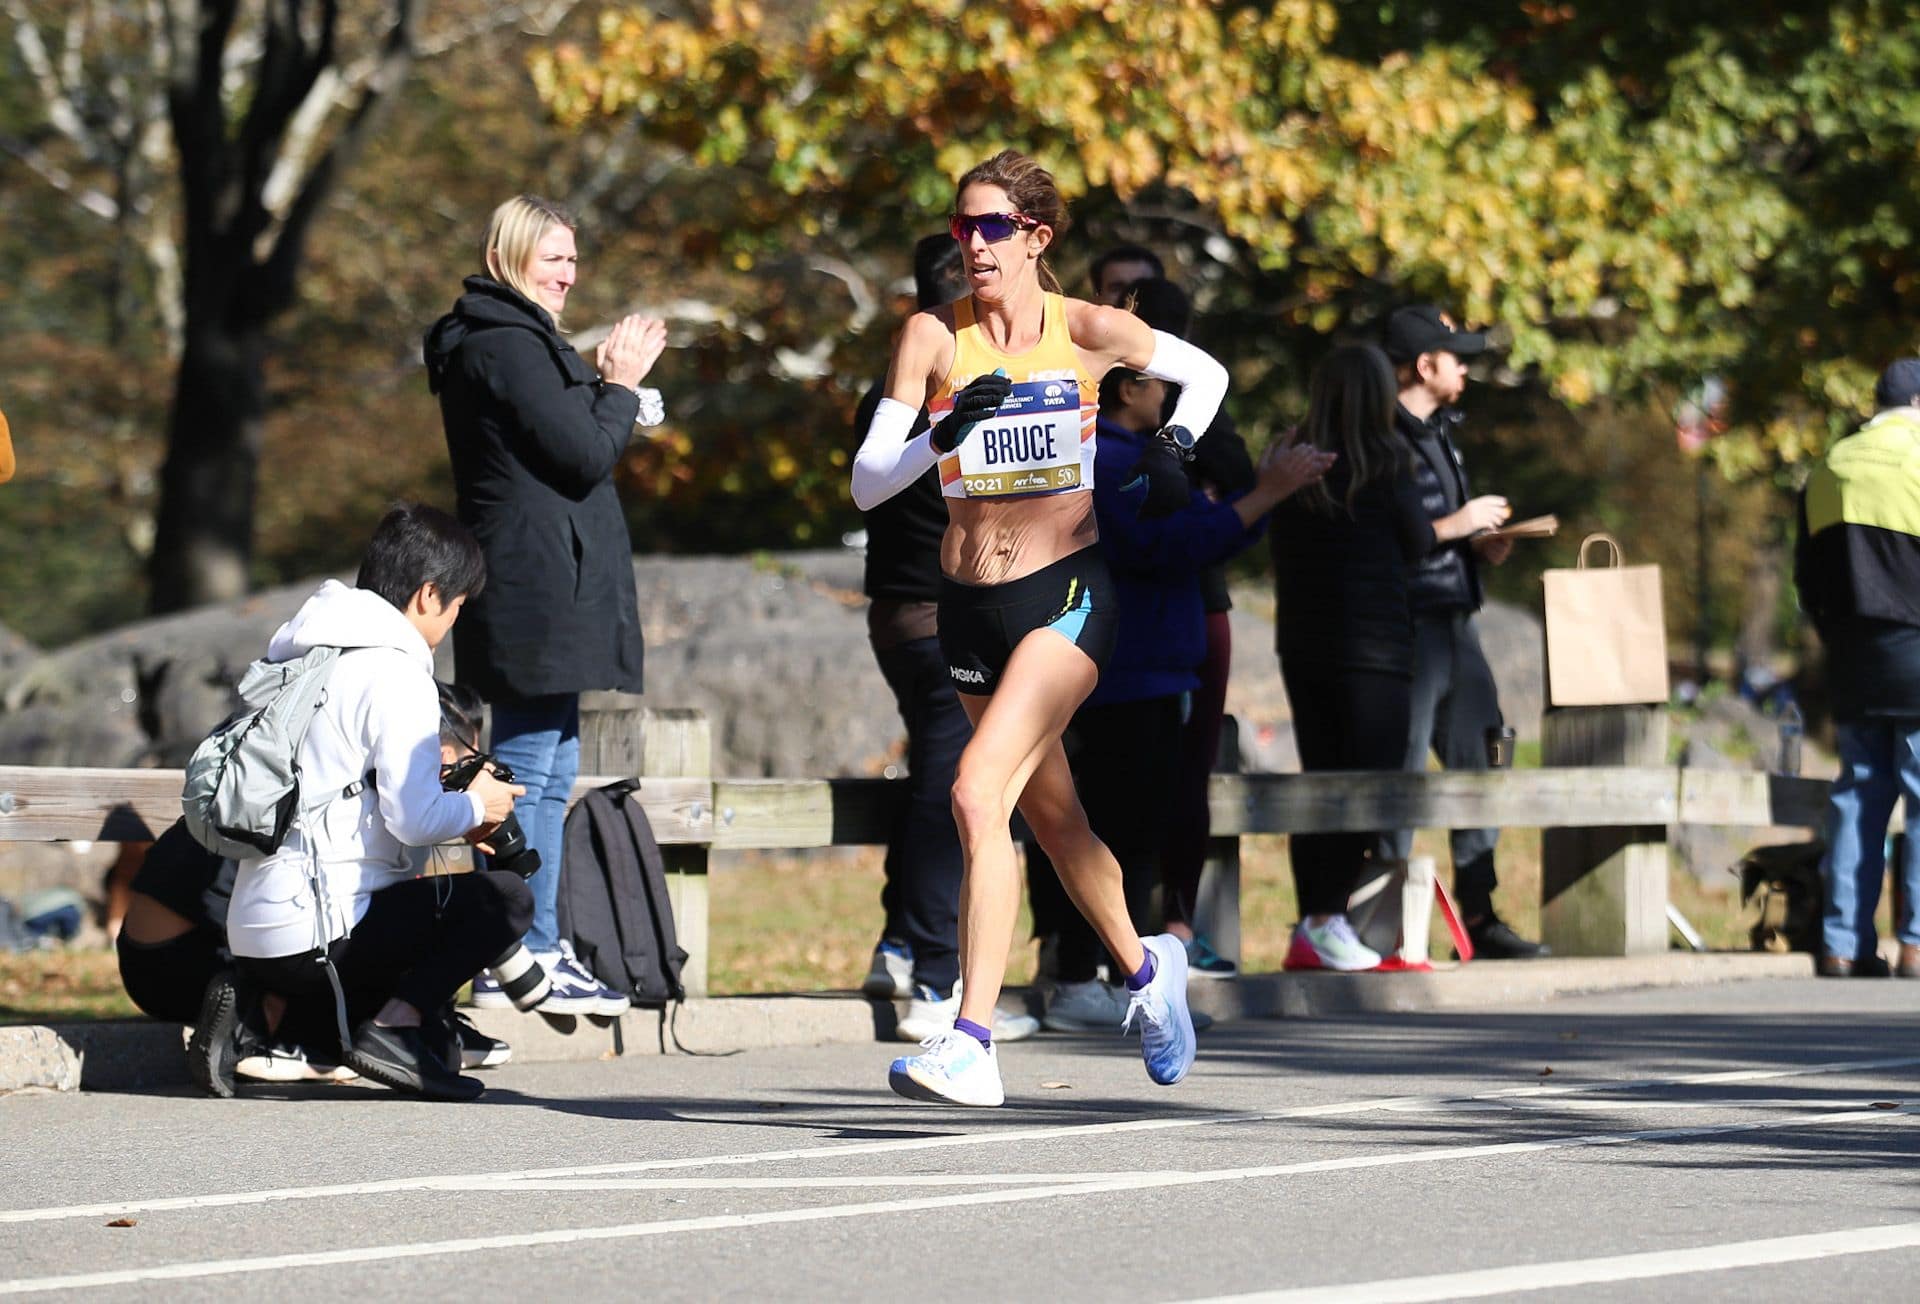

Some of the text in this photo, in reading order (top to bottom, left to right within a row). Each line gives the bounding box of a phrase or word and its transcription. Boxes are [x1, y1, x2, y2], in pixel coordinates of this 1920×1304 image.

[1043, 397, 1066, 406] TATA
[983, 424, 1057, 465] BRUCE
[965, 477, 1003, 492] 2021
[950, 665, 985, 683] HOKA
